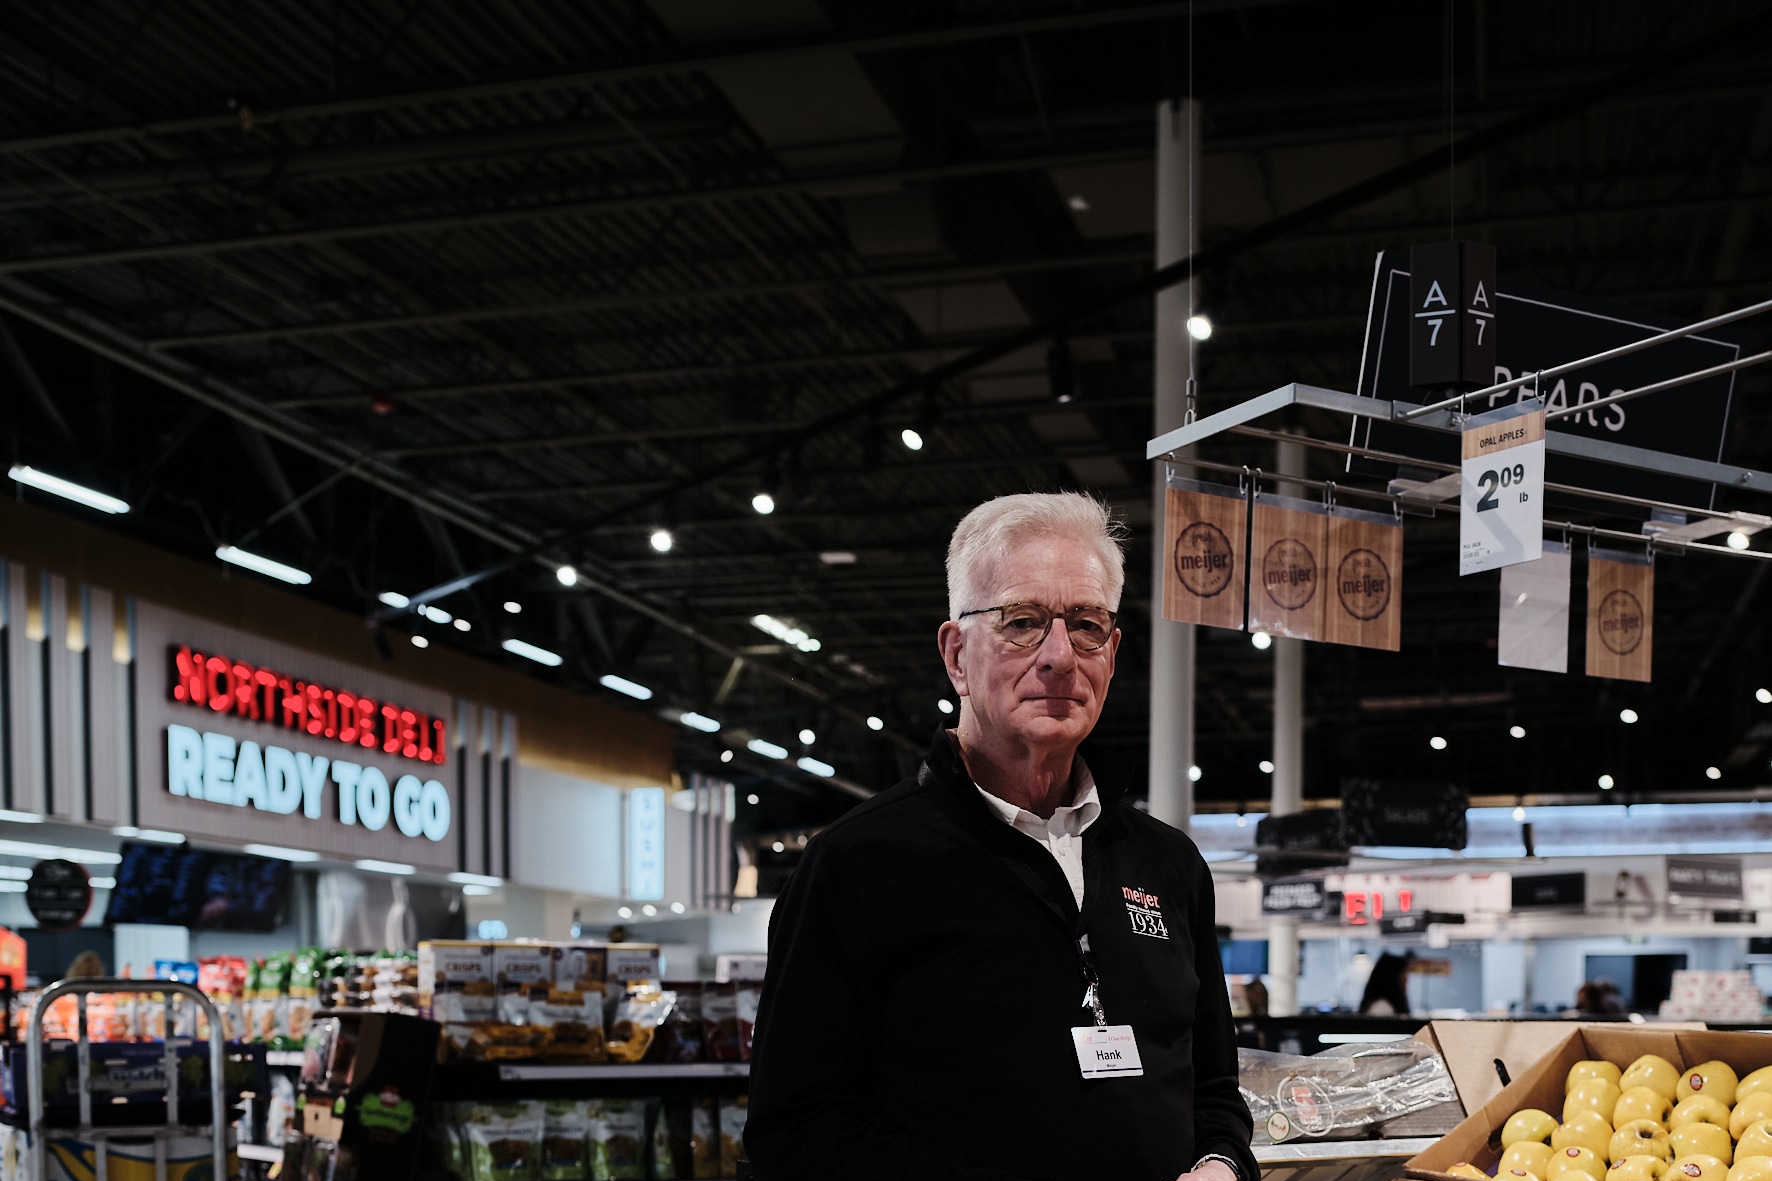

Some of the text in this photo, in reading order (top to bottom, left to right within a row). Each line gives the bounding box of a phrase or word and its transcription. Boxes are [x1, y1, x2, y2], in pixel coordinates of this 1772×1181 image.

[1423, 280, 1448, 308] A
[1473, 280, 1489, 308] A
[1427, 318, 1443, 346] 7
[1476, 320, 1486, 346] 7
[1480, 428, 1524, 448] OPAL APPLES
[1520, 492, 1528, 502] lb
[1180, 550, 1228, 572] meijer
[1268, 564, 1312, 587] meijer
[1342, 574, 1385, 598] meijer
[1603, 612, 1638, 633] meijer
[174, 645, 446, 764] NORTHSIDE DELI
[168, 724, 450, 842] READY TO GO
[1121, 886, 1160, 910] meijer
[1128, 911, 1168, 936] 1934
[1096, 1050, 1122, 1060] Hank
